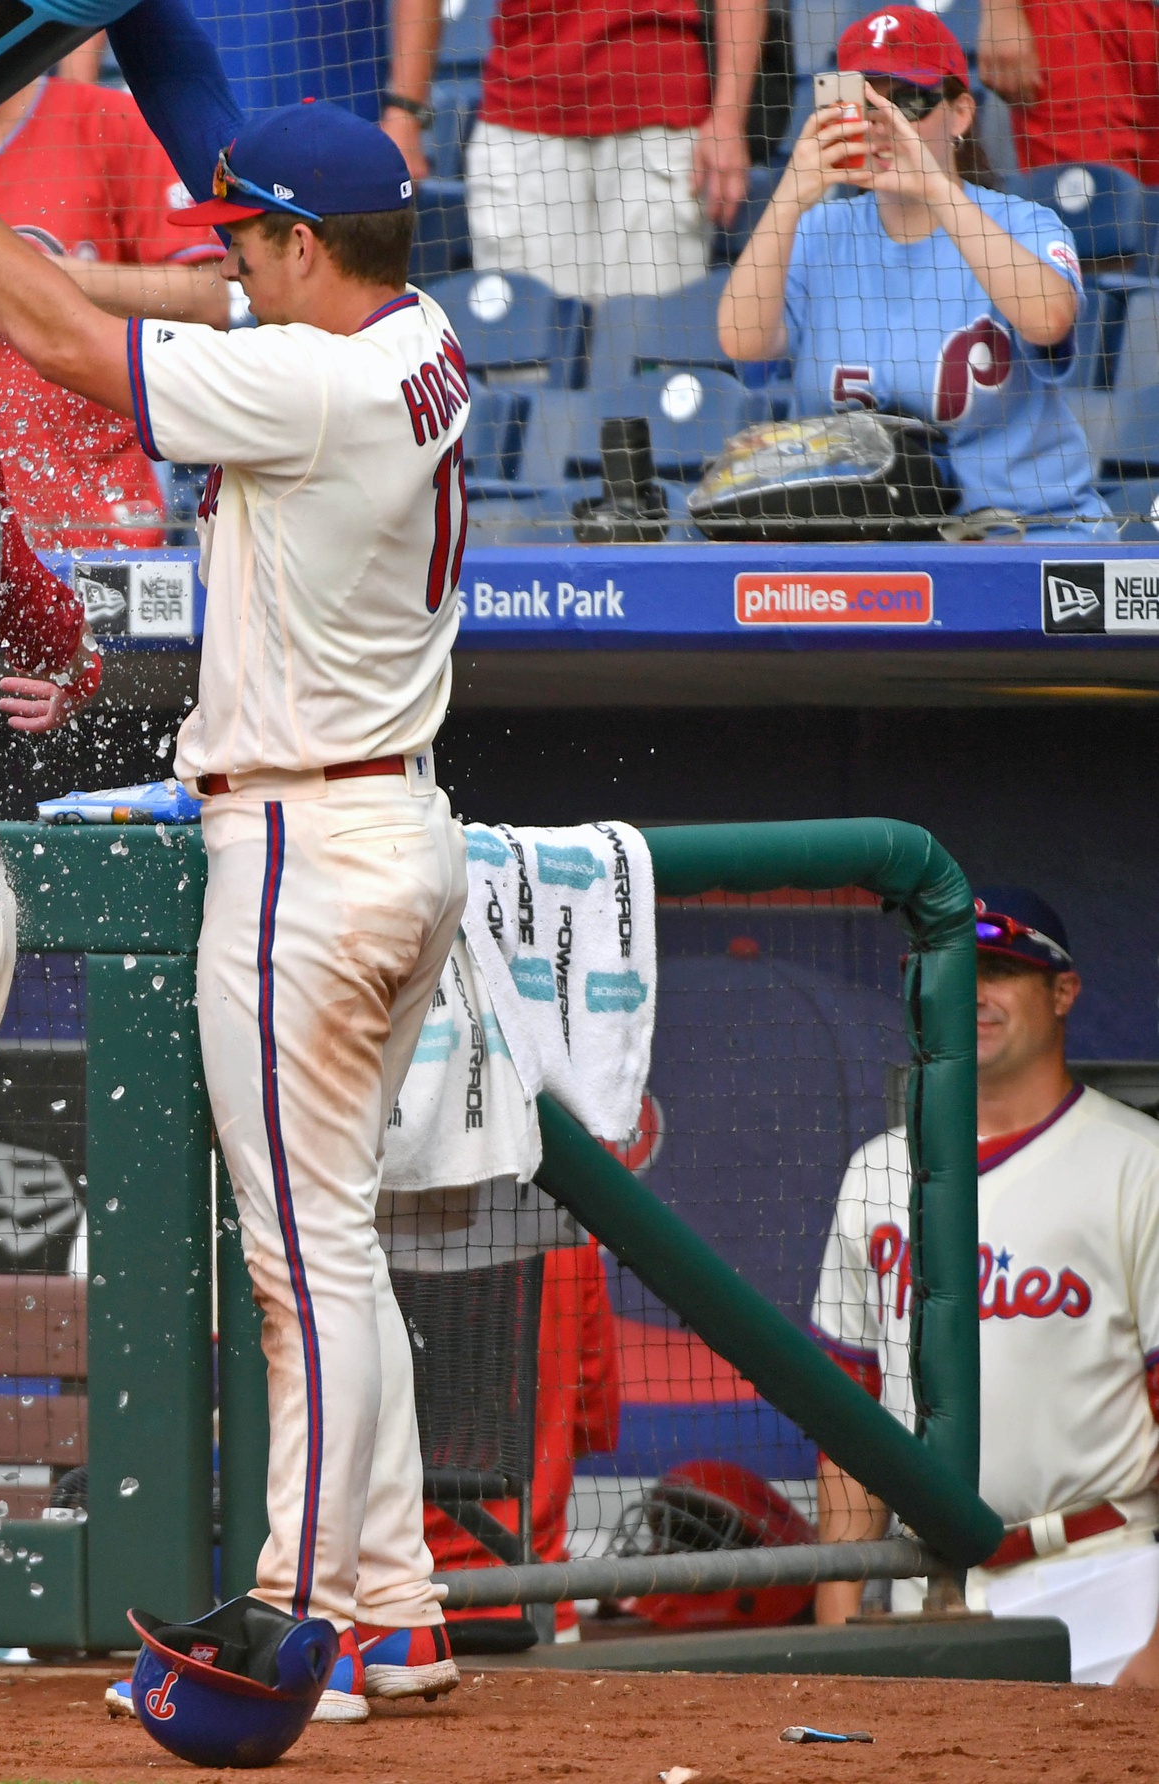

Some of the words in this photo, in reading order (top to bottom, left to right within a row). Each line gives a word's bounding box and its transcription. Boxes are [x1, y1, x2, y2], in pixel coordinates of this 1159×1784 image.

[933, 314, 1012, 422] P
[831, 365, 879, 414] 5
[140, 579, 183, 598] NEW
[474, 580, 550, 617] Bank
[557, 579, 625, 617] Park
[744, 584, 922, 618] phillies.com
[1115, 577, 1159, 598] NEW
[140, 600, 183, 620] ERA
[1116, 599, 1159, 620] ERA
